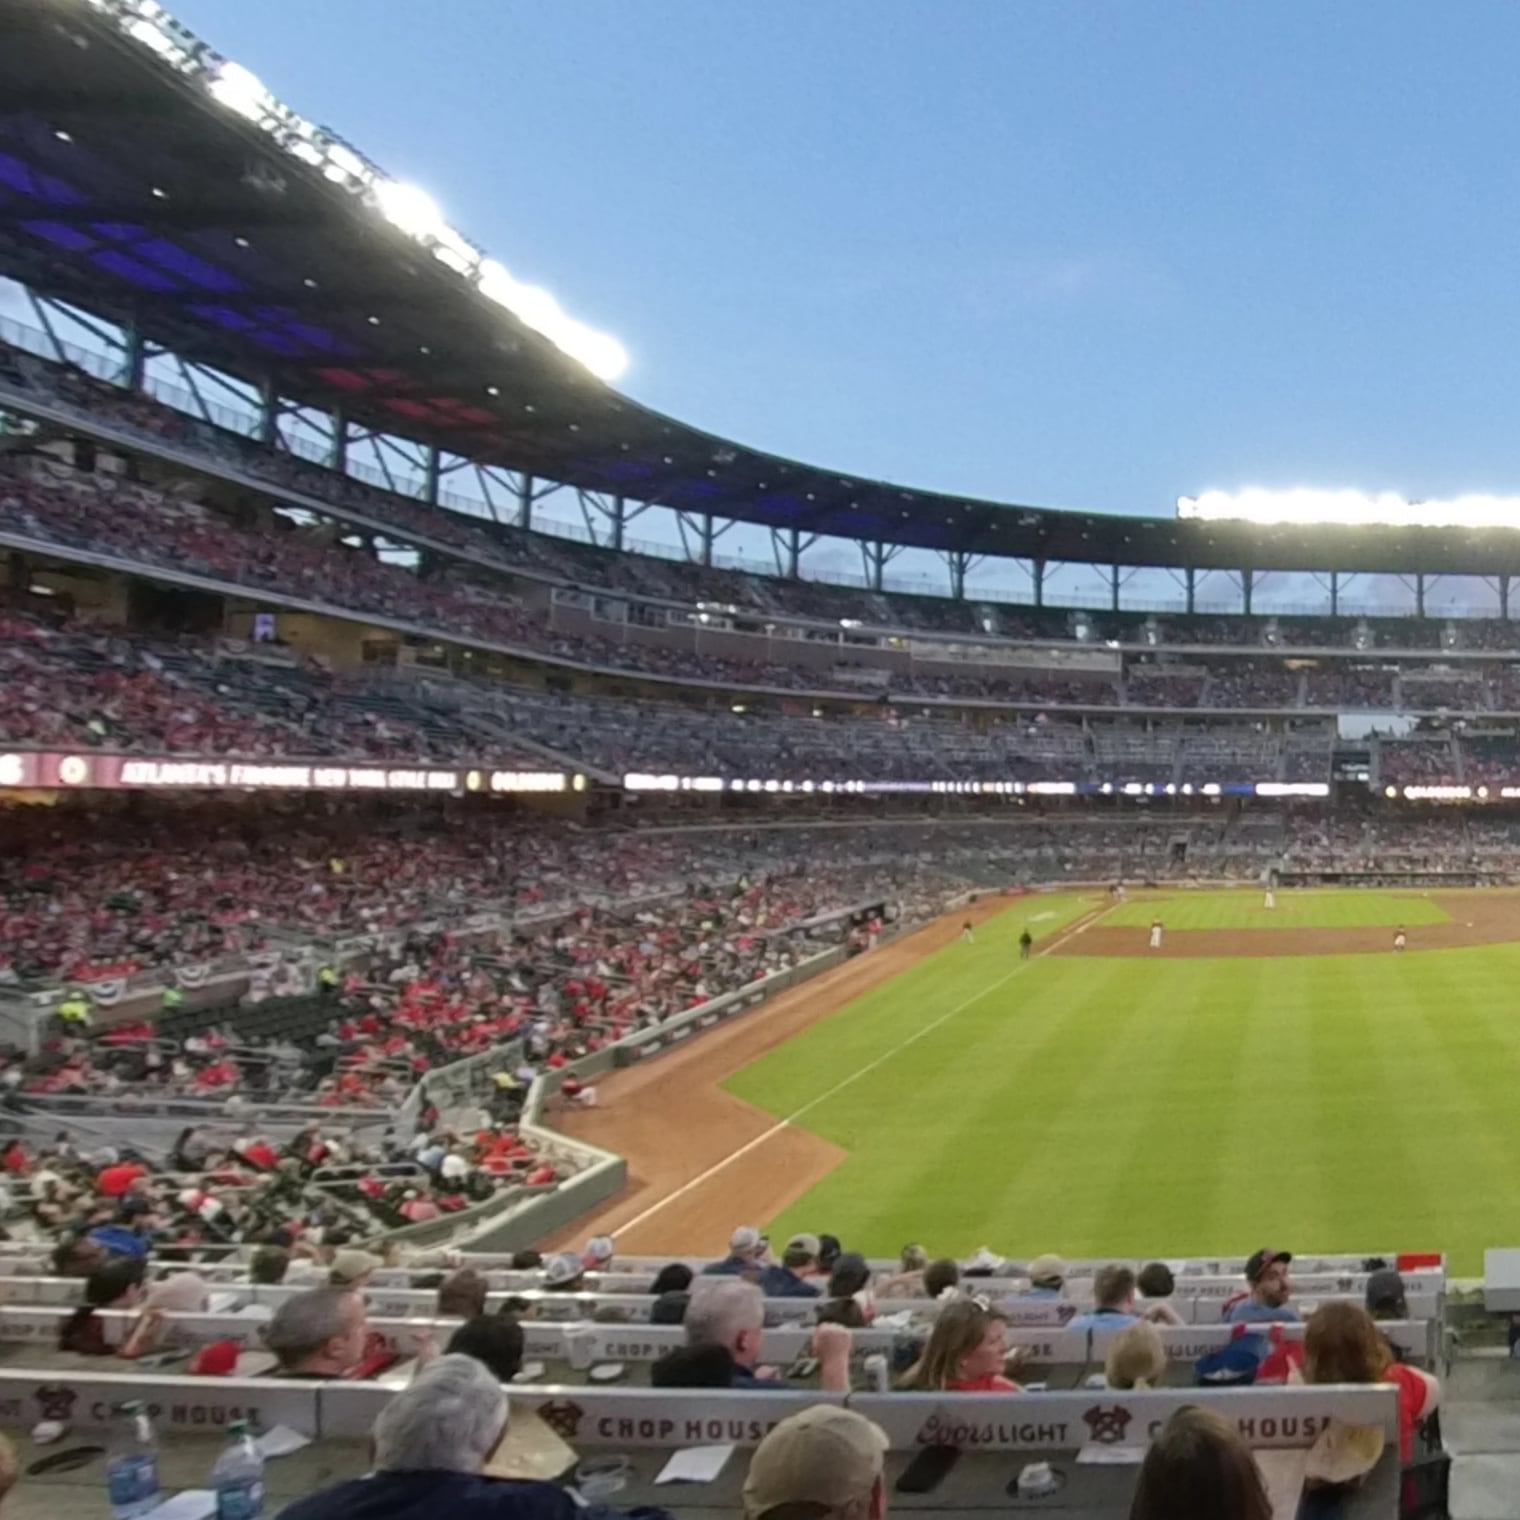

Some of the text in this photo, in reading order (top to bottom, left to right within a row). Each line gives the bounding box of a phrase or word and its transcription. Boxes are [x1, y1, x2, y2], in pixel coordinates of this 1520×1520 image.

[598, 1417, 674, 1439] CHOP
[916, 1415, 994, 1445] Coors
[999, 1423, 1068, 1442] LIGHT
